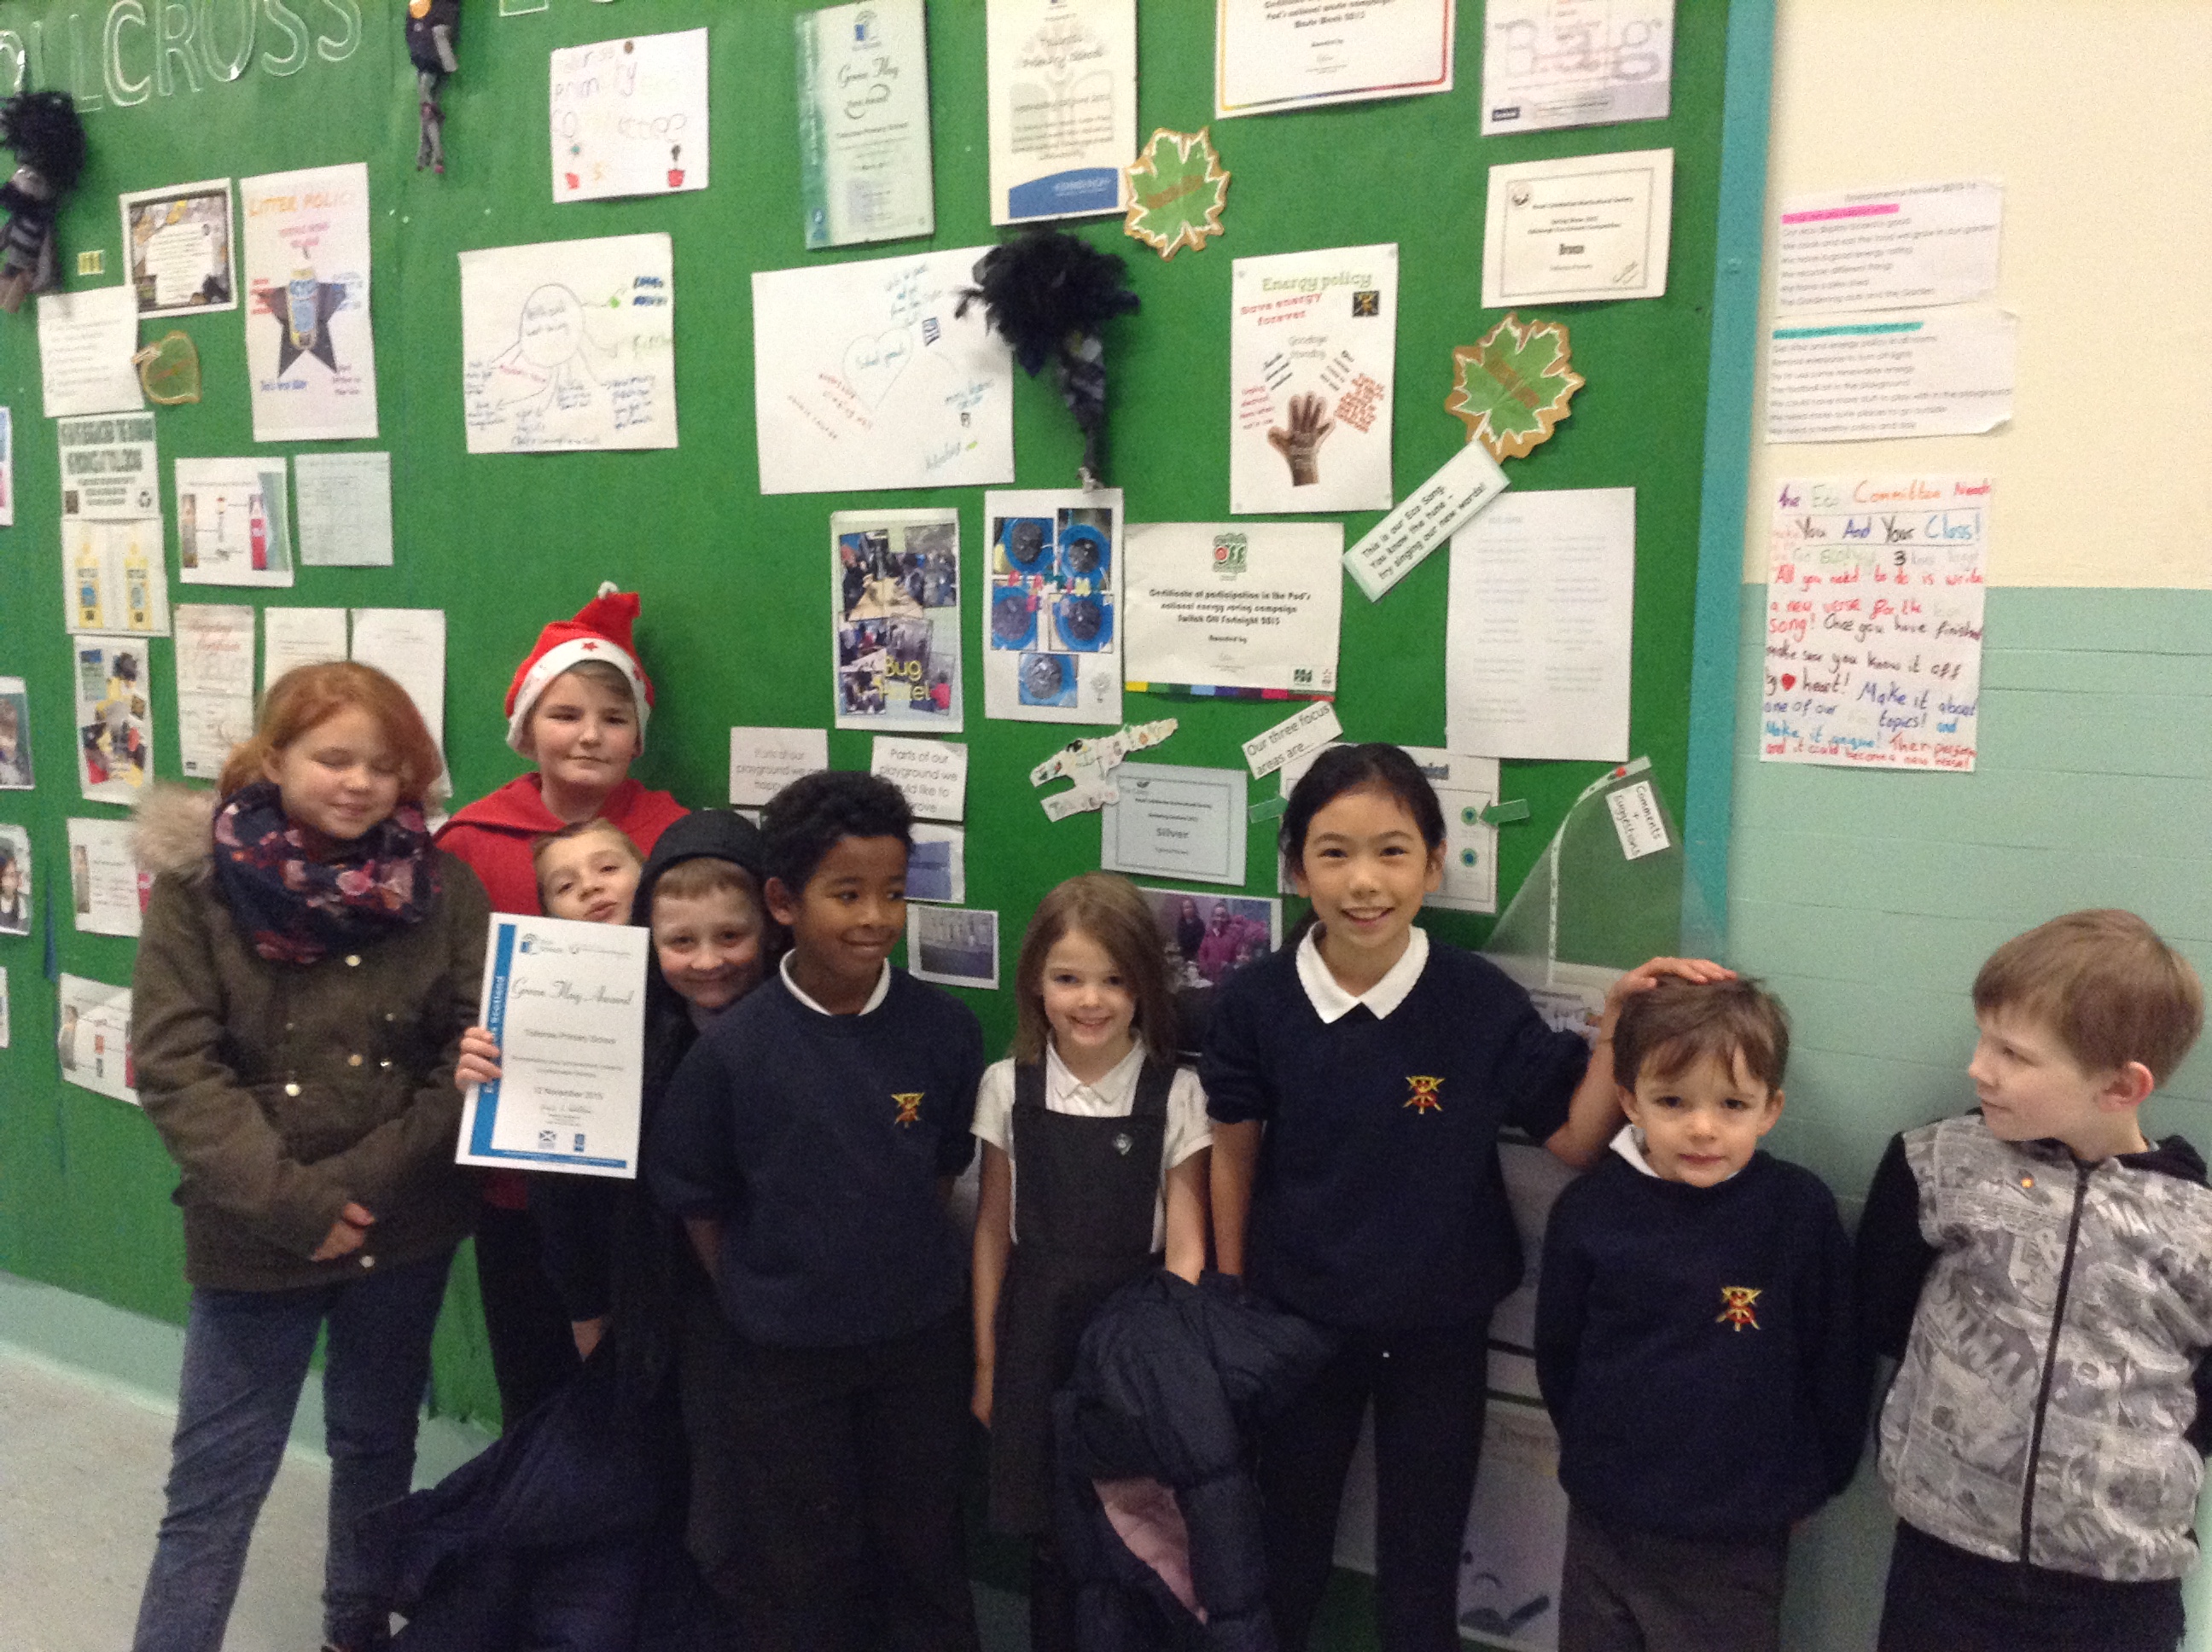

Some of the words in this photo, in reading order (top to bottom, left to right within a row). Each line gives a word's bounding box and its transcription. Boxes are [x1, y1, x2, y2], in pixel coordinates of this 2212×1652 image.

[1262, 275, 1318, 293] Energy
[1322, 270, 1372, 290] policy
[1276, 293, 1323, 308] energy
[1258, 310, 1306, 326] forever
[1854, 478, 1942, 503] Committee
[1361, 542, 1381, 558] This
[1381, 533, 1391, 544] is
[1390, 519, 1404, 535] our
[1405, 504, 1423, 521] Eco
[1370, 555, 1387, 570] You
[1386, 534, 1409, 555] know
[1408, 519, 1425, 535] the
[1425, 501, 1447, 520] tune
[1796, 515, 1827, 540] You
[1842, 515, 1872, 539] And
[1882, 514, 1916, 544] Your
[1377, 566, 1394, 580] try
[1394, 539, 1425, 567] singing
[1423, 525, 1438, 542] our
[1439, 509, 1457, 527] new
[1894, 550, 1907, 567] 3
[1149, 587, 1193, 598] Certificate
[1195, 589, 1204, 598] of
[1205, 590, 1260, 601] participation
[1261, 590, 1270, 600] in
[1272, 591, 1285, 600] the
[1161, 601, 1194, 610] national
[1196, 603, 1225, 614] energy
[1254, 605, 1298, 615] campaign
[1178, 614, 1204, 624] Switch
[1220, 614, 1260, 627] Fortnight
[1823, 612, 1855, 632] Once
[1854, 620, 1884, 643] you
[1893, 614, 1927, 633] have
[885, 656, 923, 682] Bug
[1828, 652, 1857, 674] you
[1867, 649, 1901, 671] know
[1906, 654, 1921, 673] it
[1930, 661, 1963, 681] off
[1763, 700, 1789, 713] one
[1791, 697, 1813, 718] of
[1814, 702, 1838, 715] our
[1855, 680, 1906, 707] Make
[1912, 689, 1930, 711] it
[1937, 693, 1977, 717] about
[1246, 737, 1269, 757] Our
[1268, 721, 1298, 746] three
[1298, 702, 1330, 730] focus
[890, 748, 917, 762] Parts
[917, 748, 930, 762] of
[931, 753, 949, 764] our
[1255, 752, 1285, 777] areas
[736, 765, 790, 776] playground
[879, 765, 940, 782] playground
[940, 772, 958, 782] we
[918, 783, 936, 797] like
[938, 786, 950, 798] to
[1636, 785, 1661, 840] Comments
[1155, 827, 1190, 840] Silver
